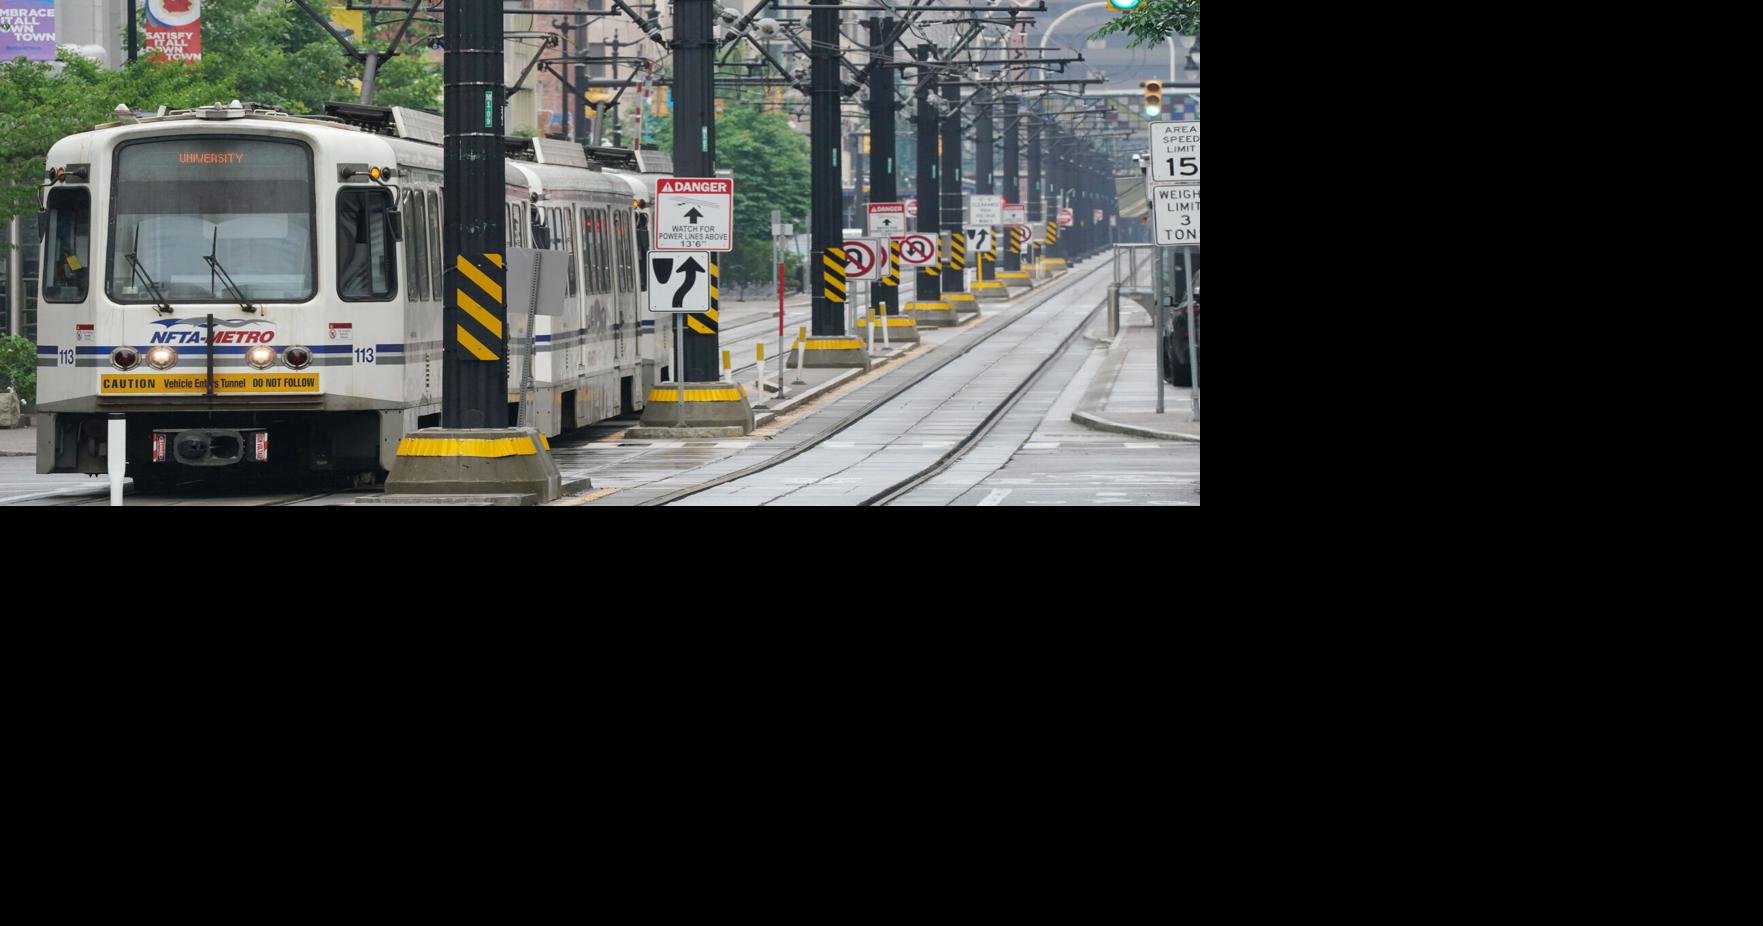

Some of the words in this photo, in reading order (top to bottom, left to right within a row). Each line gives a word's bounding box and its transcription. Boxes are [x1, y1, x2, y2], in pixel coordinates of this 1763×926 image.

[1, 17, 13, 25] IT
[14, 17, 40, 25] ALL
[14, 33, 56, 41] TOWN
[155, 39, 165, 47] IT
[166, 39, 188, 47] ALL
[167, 53, 202, 61] TOWN
[1165, 126, 1197, 134] AREA
[1163, 135, 1200, 144] SPEED
[1167, 145, 1196, 153] LIMIT
[179, 152, 244, 164] UNIVERSITY
[1166, 157, 1198, 177] 15
[674, 182, 727, 192] DANGER
[1167, 201, 1200, 212] LIMIT
[1181, 215, 1191, 226] 3
[1165, 229, 1200, 241] TON
[59, 349, 74, 365] 113
[354, 347, 374, 363] 113
[103, 379, 155, 389] CAUTION
[163, 378, 193, 388] Vehicle
[194, 378, 219, 388] Ents
[220, 378, 246, 388] Tunnel
[252, 378, 264, 388] DO
[265, 378, 281, 388] NOT
[284, 378, 315, 388] FOLLOW
